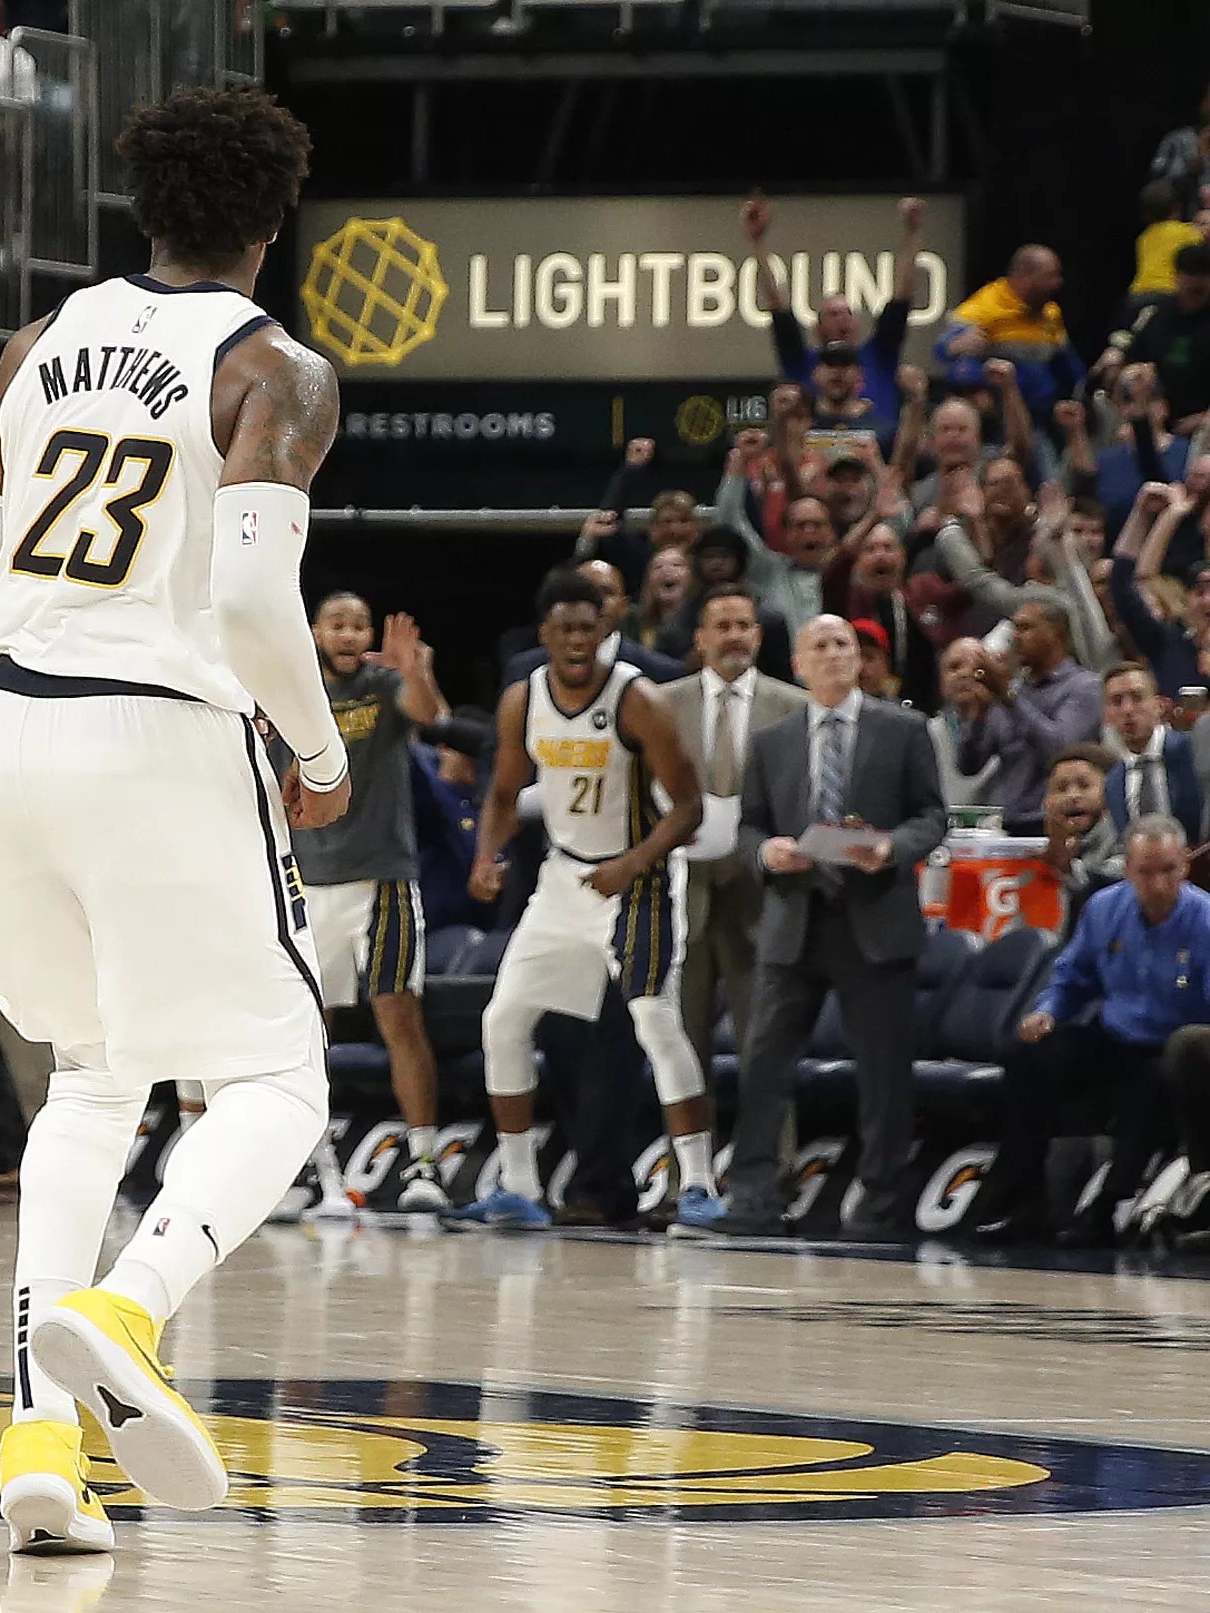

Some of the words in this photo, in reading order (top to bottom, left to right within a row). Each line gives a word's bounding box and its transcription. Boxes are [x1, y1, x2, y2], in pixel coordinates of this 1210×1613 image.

[467, 250, 948, 329] LIGHTBOUND
[39, 346, 189, 420] MATTHEWS
[346, 412, 557, 440] RESTROOMS
[10, 427, 176, 590] 23
[569, 776, 603, 814] 21
[915, 1142, 1002, 1233] G
